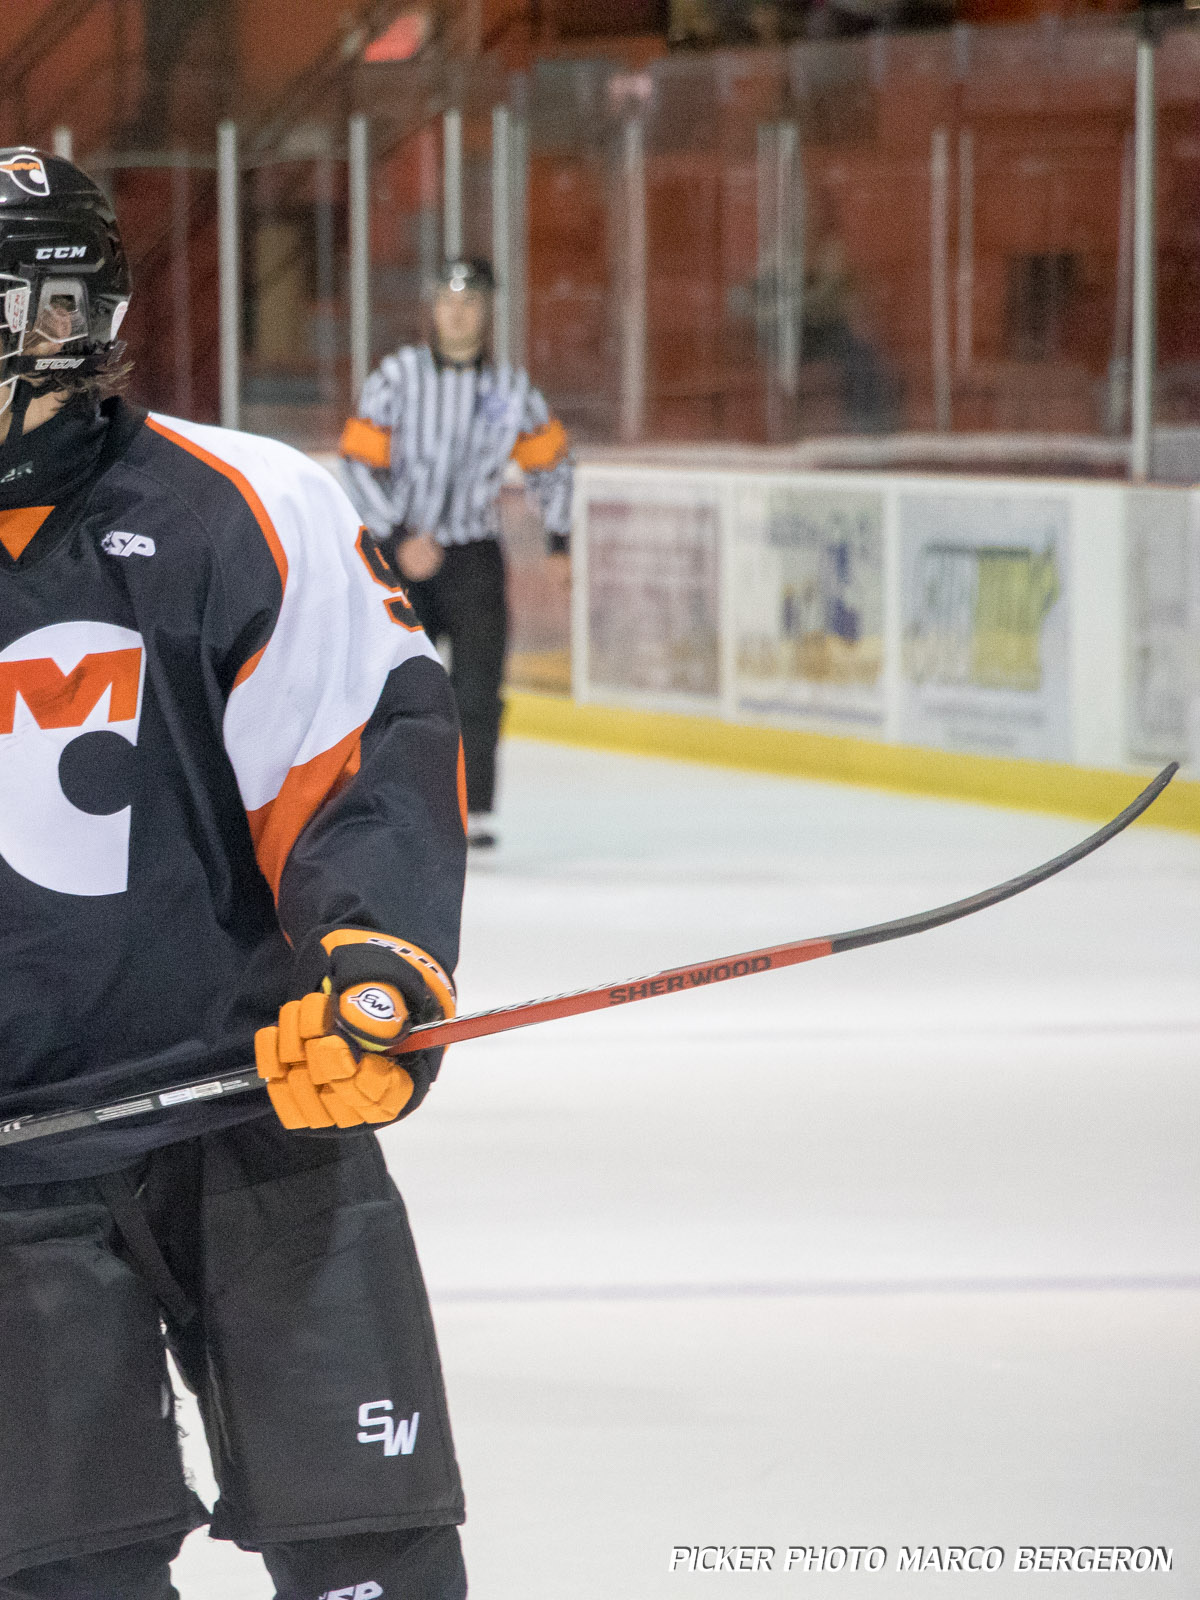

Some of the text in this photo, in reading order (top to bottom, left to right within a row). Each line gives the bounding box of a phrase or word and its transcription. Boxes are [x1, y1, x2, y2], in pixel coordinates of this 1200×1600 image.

[36, 246, 88, 260] CCM
[34, 358, 86, 371] CCM
[357, 1399, 420, 1457] SW
